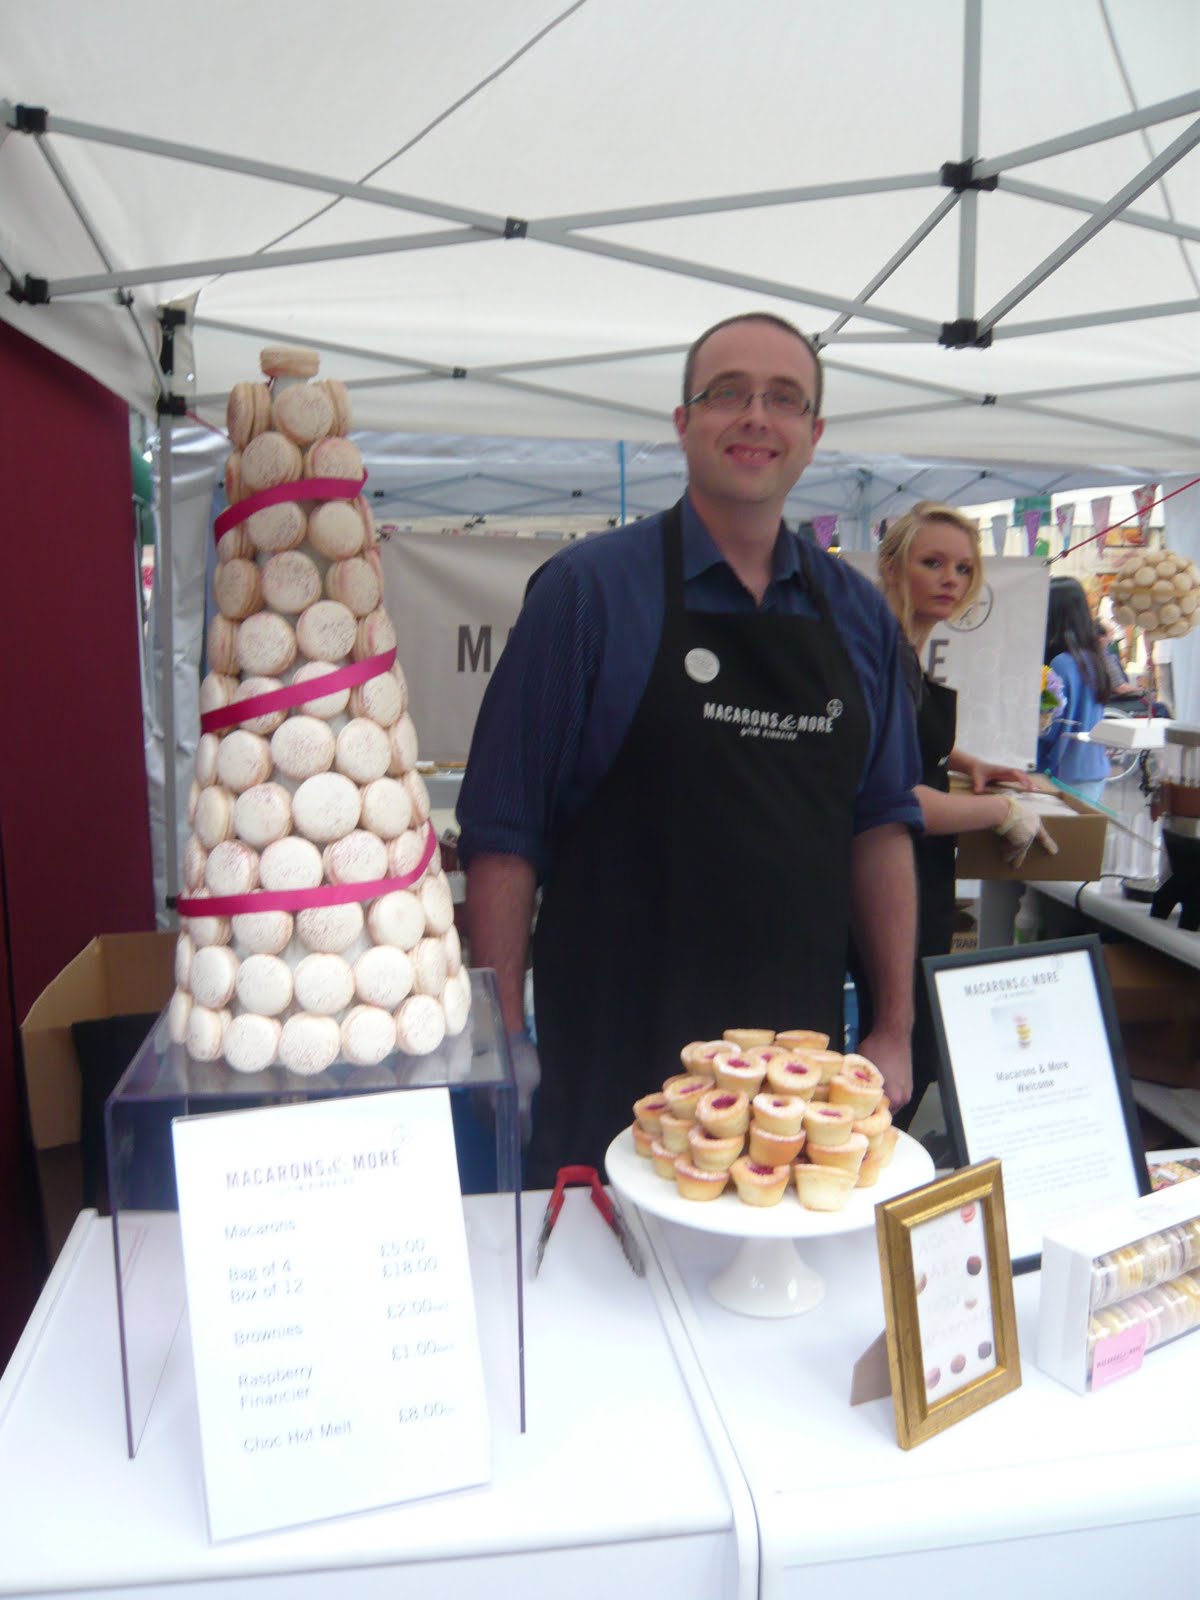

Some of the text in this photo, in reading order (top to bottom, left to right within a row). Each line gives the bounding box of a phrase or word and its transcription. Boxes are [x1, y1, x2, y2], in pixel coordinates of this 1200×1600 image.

[457, 625, 500, 673] M
[703, 702, 779, 729] MACARONS
[797, 715, 834, 733] MORE
[964, 976, 1019, 998] MACARONS
[1032, 971, 1061, 986] MORE
[996, 1066, 1037, 1081] Macarons
[1048, 1060, 1070, 1072] More
[1017, 1078, 1055, 1093] Welcome
[225, 1159, 325, 1191] MACARONS
[352, 1148, 401, 1171] MORE
[224, 1218, 297, 1240] Macarons
[228, 1264, 258, 1283] Bag
[262, 1259, 276, 1277] of
[230, 1286, 257, 1304] Box
[263, 1281, 276, 1298] of
[233, 1322, 304, 1346] Brownies
[237, 1364, 314, 1389] Raspberry
[239, 1386, 311, 1410] Financier
[243, 1419, 353, 1454] Choc Hot Melt
